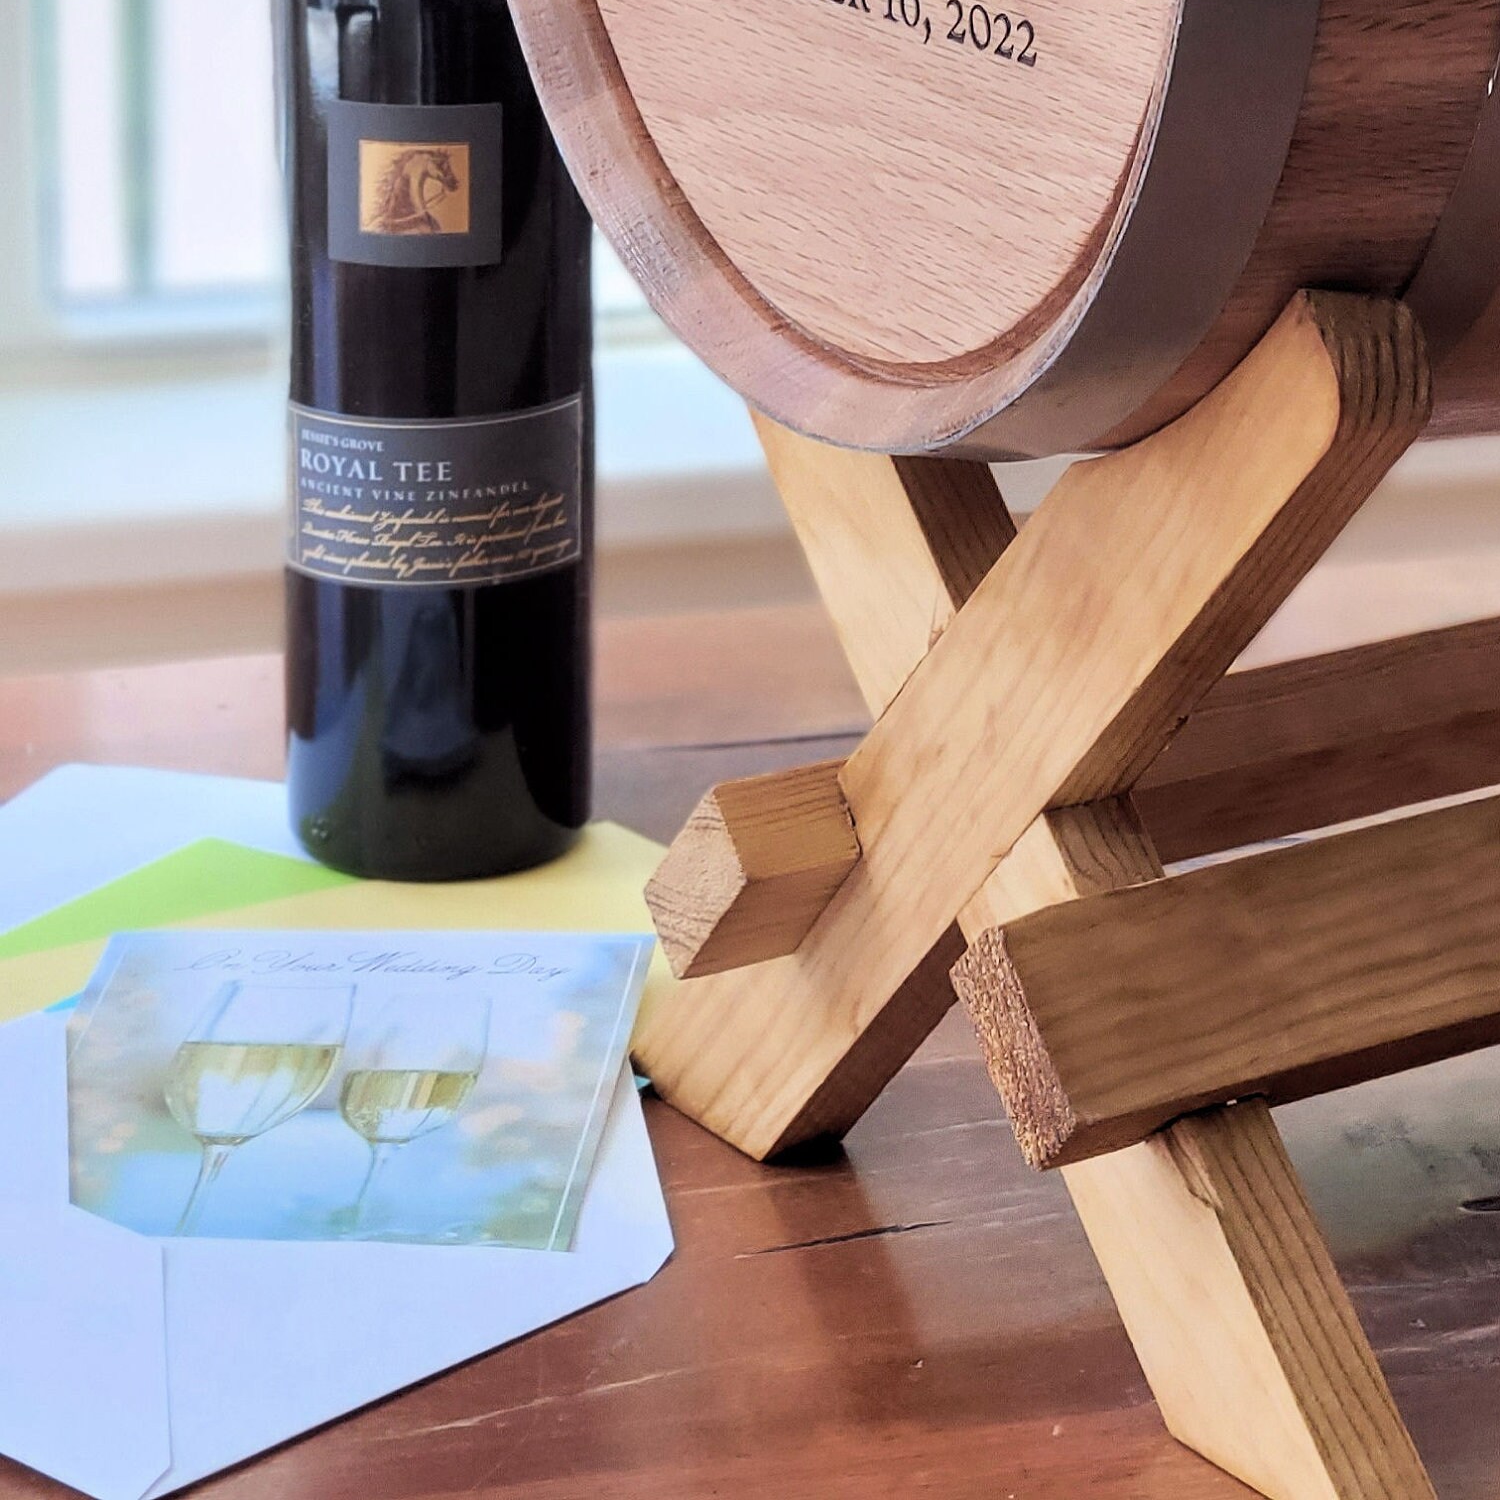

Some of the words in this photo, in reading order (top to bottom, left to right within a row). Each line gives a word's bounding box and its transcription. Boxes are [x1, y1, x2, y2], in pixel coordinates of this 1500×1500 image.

[340, 437, 385, 453] GROVE
[301, 447, 383, 481] ROYAL
[392, 461, 452, 482] TEE
[301, 476, 363, 499] ANCIENT
[372, 489, 416, 501] VINE
[426, 481, 530, 501] ZINFANDEL
[250, 950, 343, 974] Your
[347, 950, 478, 981] Wedding
[487, 952, 571, 982] Day
